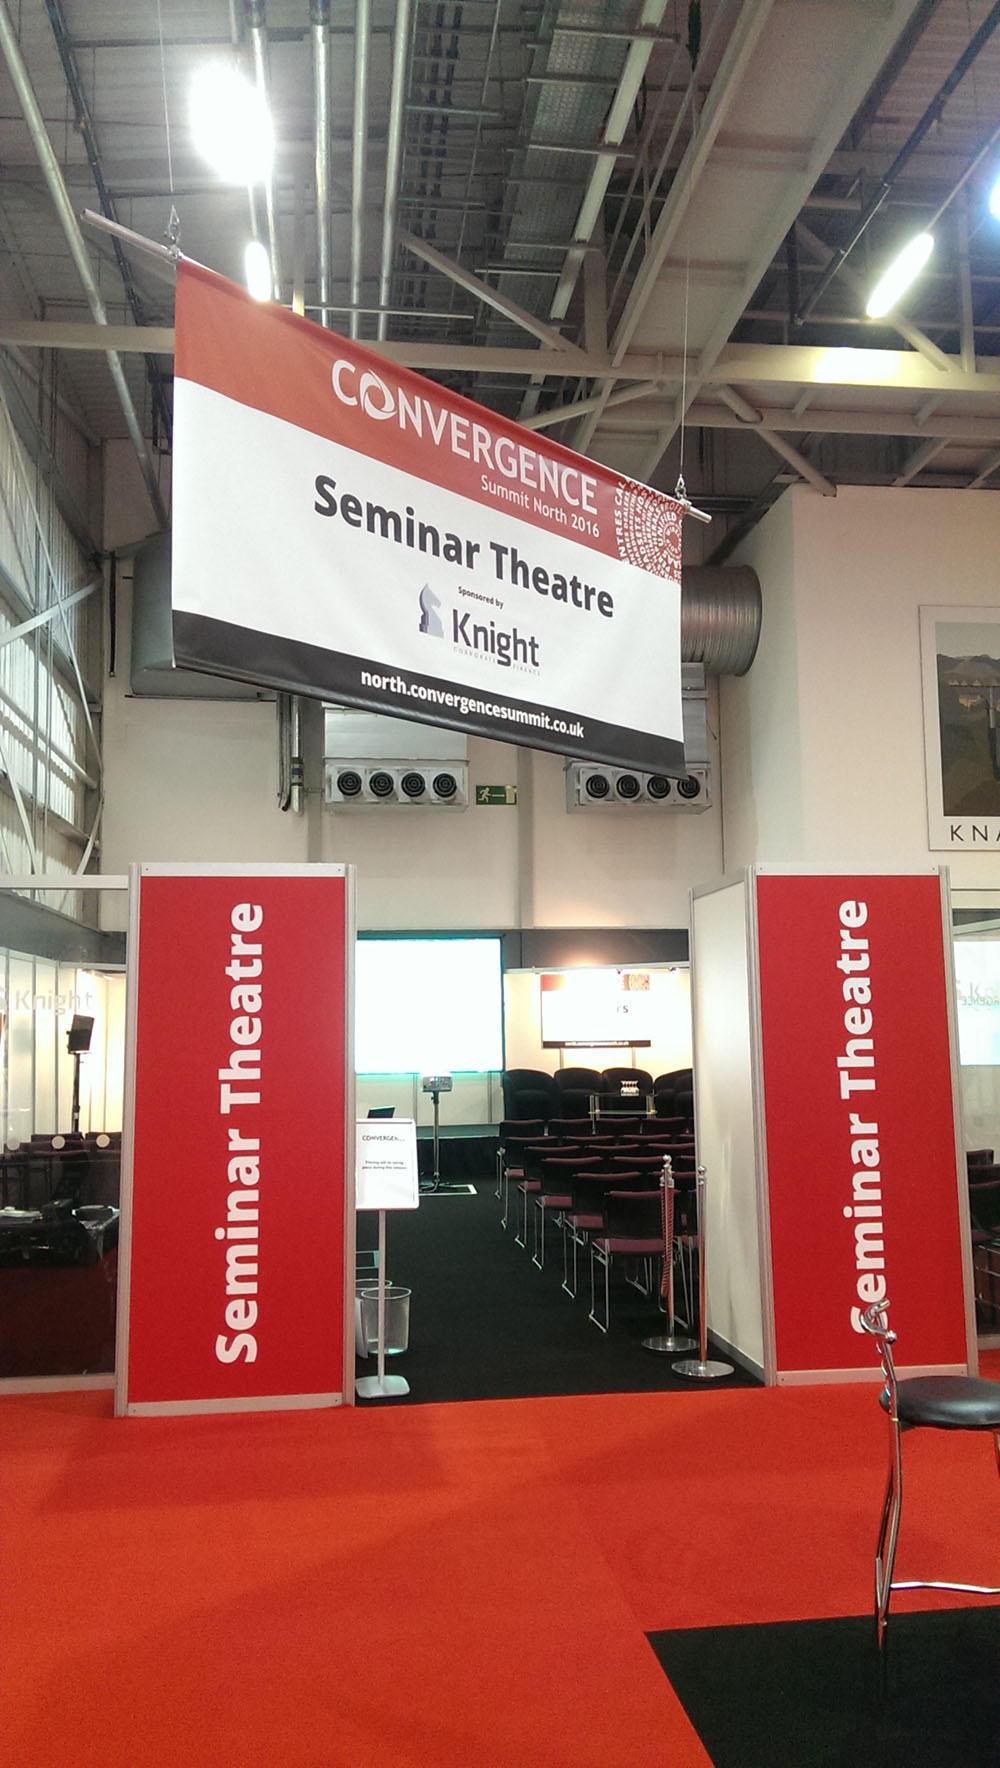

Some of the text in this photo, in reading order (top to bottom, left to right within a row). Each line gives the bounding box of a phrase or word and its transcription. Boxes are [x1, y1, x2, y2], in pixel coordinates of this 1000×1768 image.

[332, 360, 598, 515] CONVERGENCE
[481, 474, 600, 538] Summit North 2016
[314, 474, 480, 570] Seminar
[490, 541, 614, 618] Theatre
[458, 586, 504, 609] Sponsored by
[452, 608, 539, 667] Knight
[361, 670, 584, 738] north.convergencesummit.co.uk
[950, 824, 1000, 841] KN
[15, 989, 93, 1015] Knight
[837, 900, 876, 1100] Theatre
[215, 902, 263, 1364] Seminar Theatre
